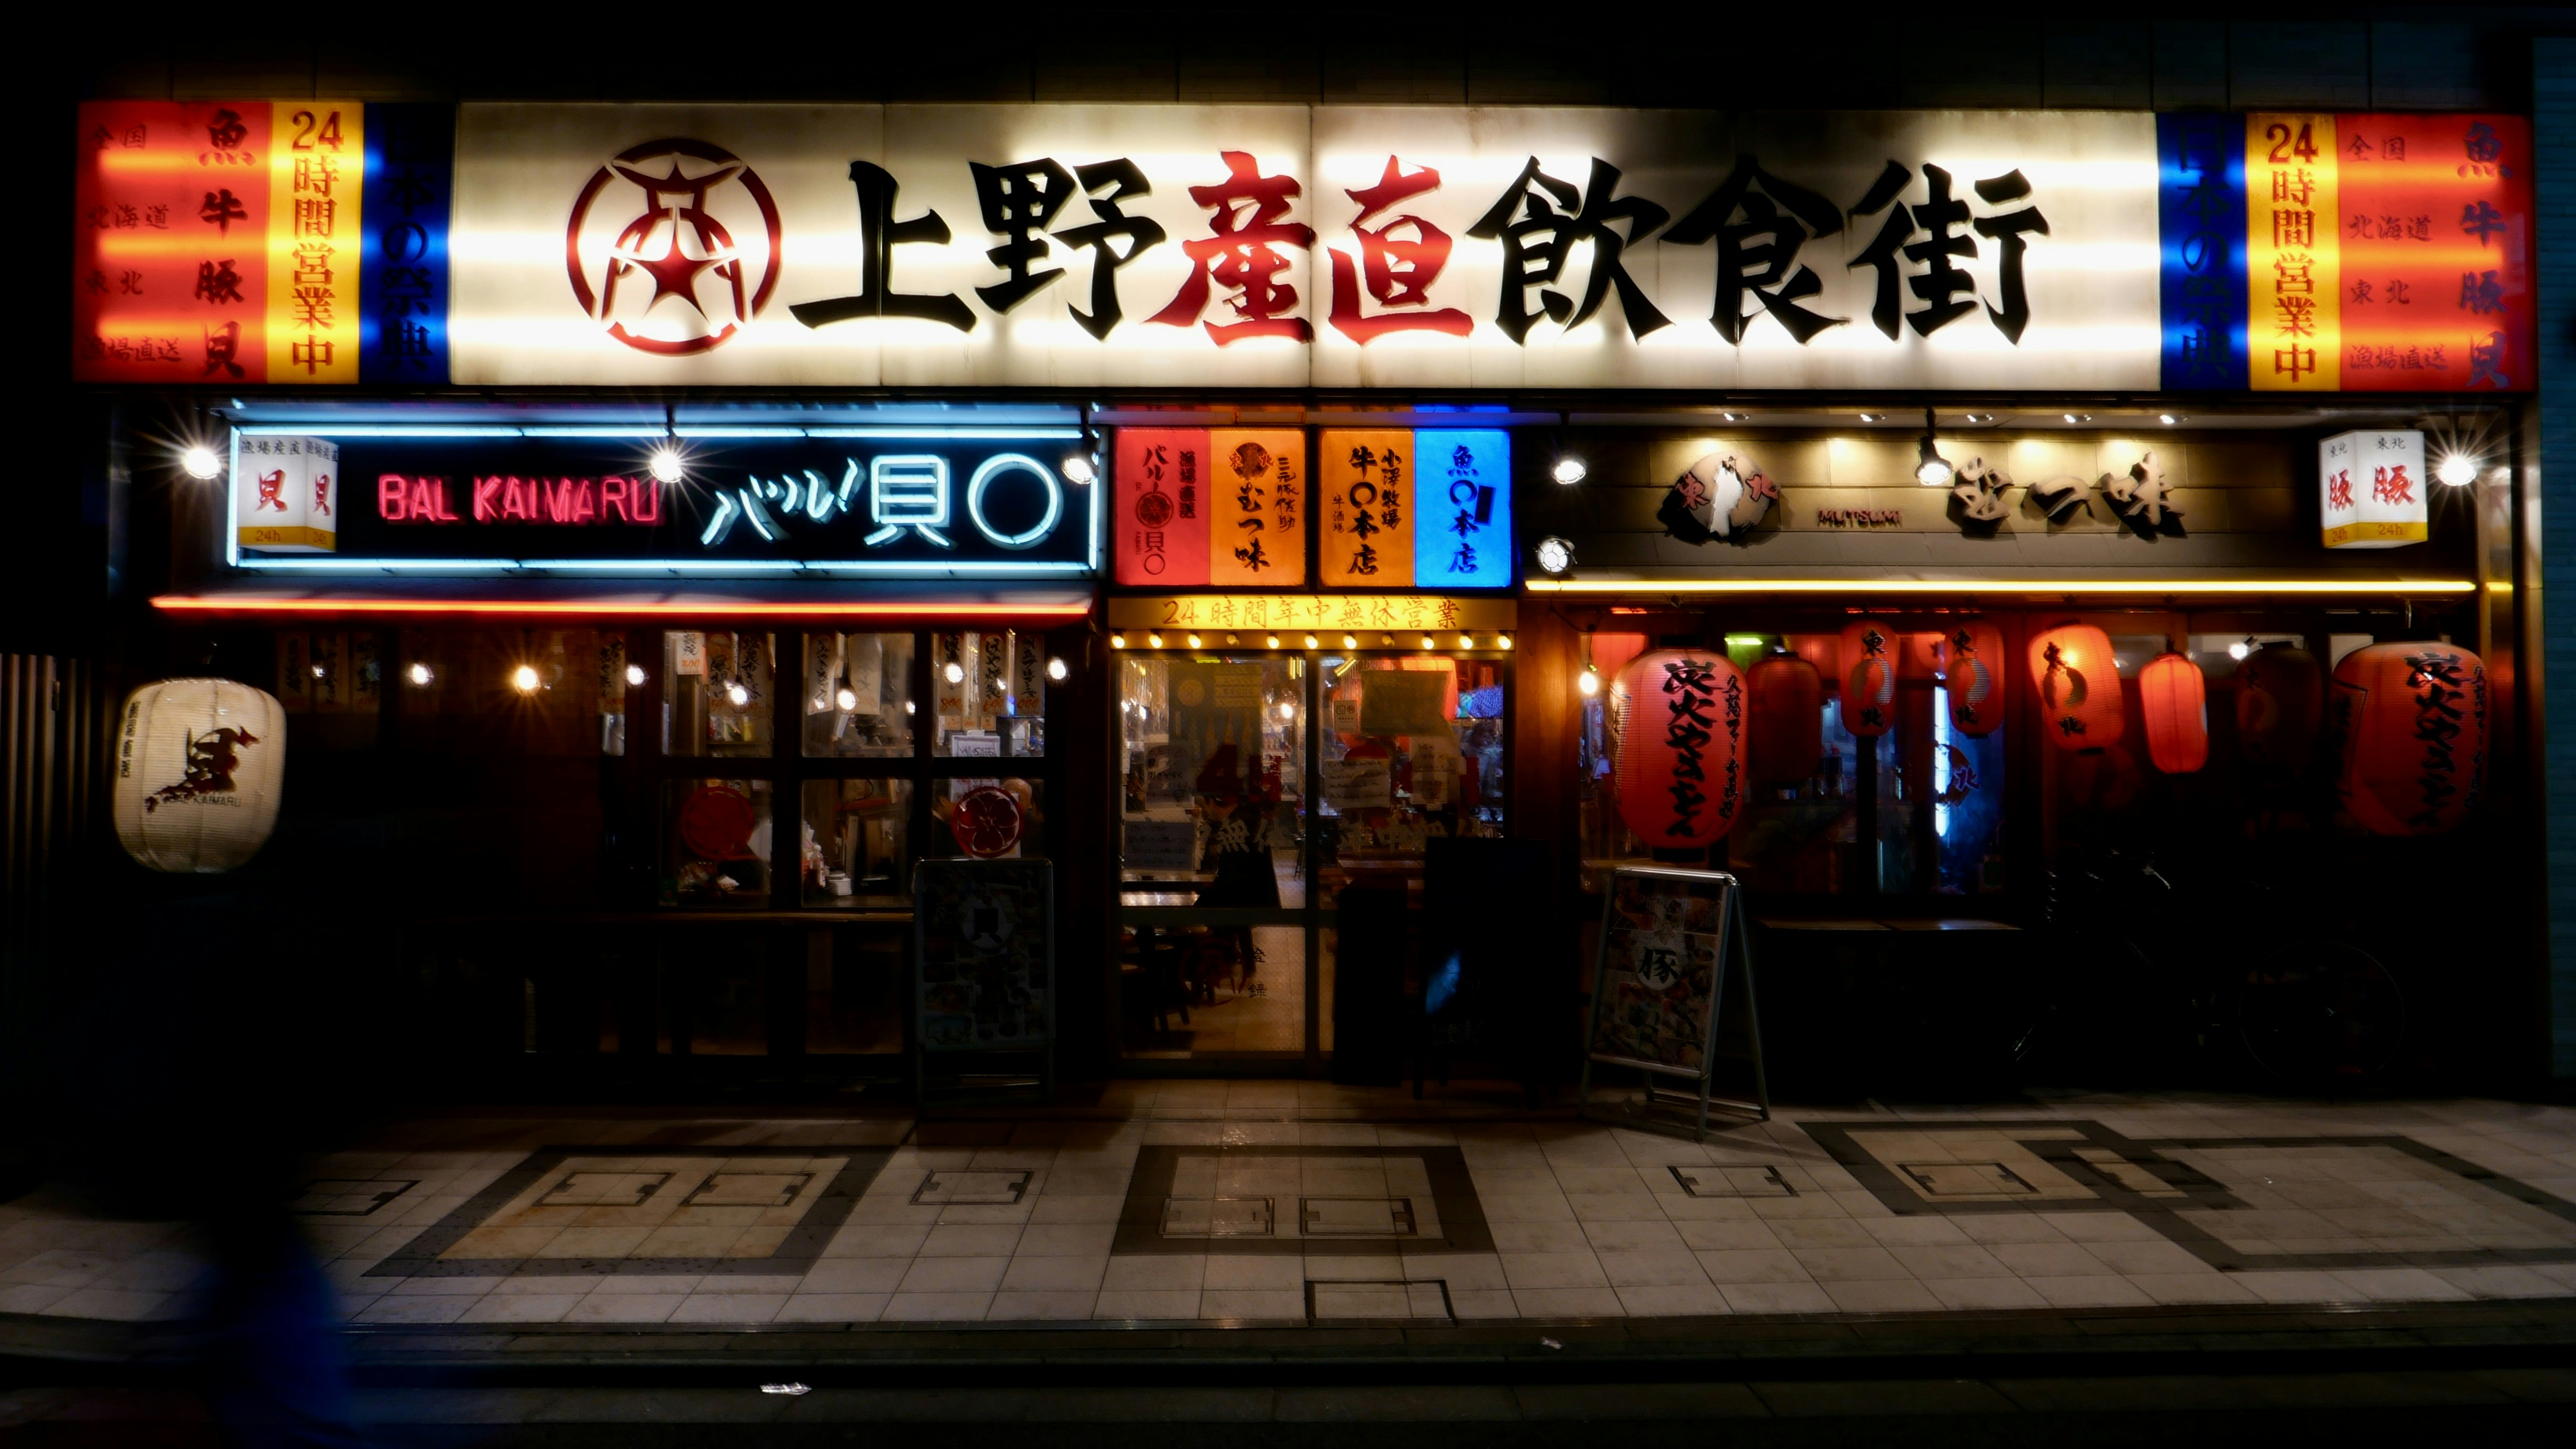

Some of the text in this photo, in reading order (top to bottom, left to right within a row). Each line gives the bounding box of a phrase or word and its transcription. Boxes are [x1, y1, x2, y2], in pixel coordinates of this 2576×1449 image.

[89, 108, 256, 167] 全国 魚
[2347, 122, 2512, 179] 全国 魚
[86, 189, 249, 240] 北海道 牛
[2349, 200, 2506, 248] 北海道 牛
[291, 110, 344, 375] 24時間営業中
[789, 150, 2051, 346] 上野産直飲食街
[2266, 123, 2319, 383] 24時間営業中
[195, 259, 245, 305] 豚
[2350, 270, 2508, 315] 東北 豚
[201, 320, 245, 379] 貝
[2349, 330, 2510, 389] 漁場直送 貝
[241, 440, 302, 456] 漁場産直
[2376, 435, 2406, 450] 東北
[255, 469, 288, 512] 貝
[313, 473, 331, 517] 貝
[379, 474, 659, 522] BAL KAIMARU
[2329, 468, 2355, 512] 豚
[2373, 464, 2416, 507] 豚
[255, 530, 281, 542] 24h
[1234, 481, 1271, 573] むつ味
[1818, 508, 1903, 525] MUTSUMI
[2333, 528, 2348, 543] 24h
[2378, 523, 2404, 536] 24h
[192, 794, 242, 808] KAIMARU
[1636, 947, 1679, 984] 豚
